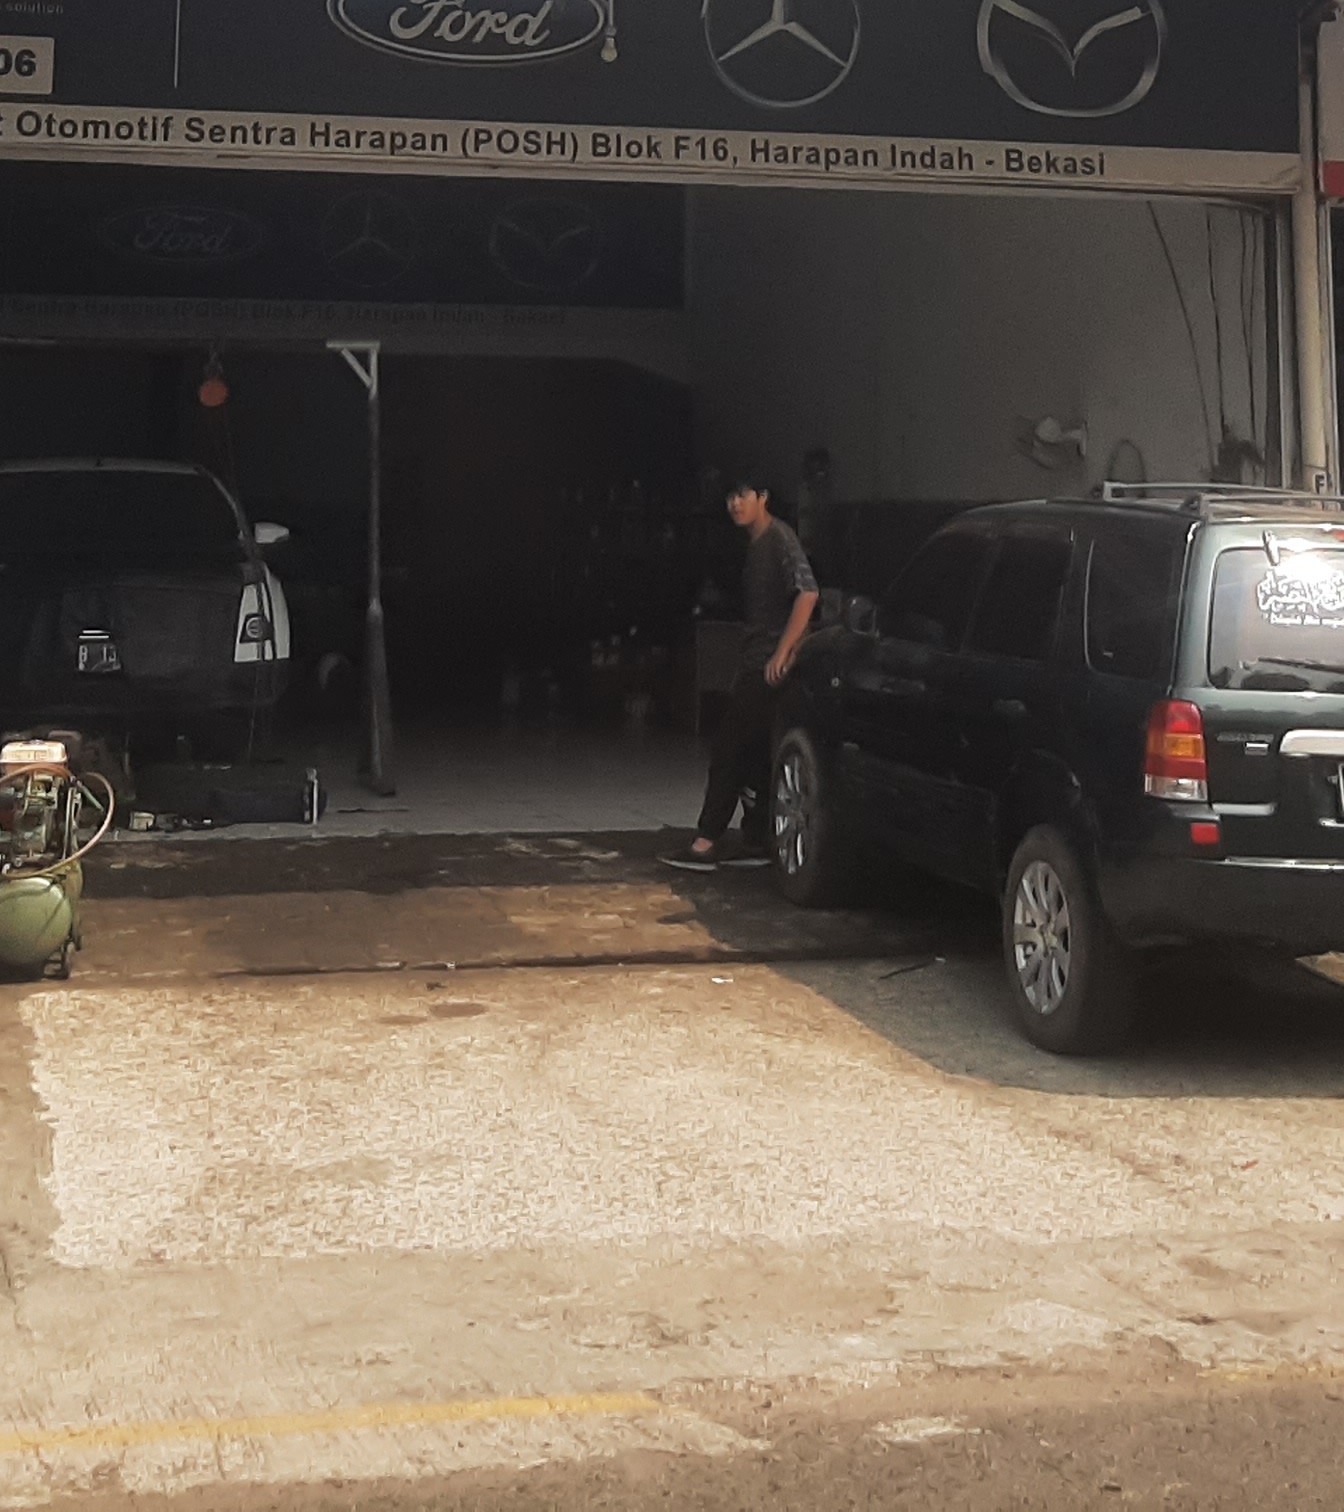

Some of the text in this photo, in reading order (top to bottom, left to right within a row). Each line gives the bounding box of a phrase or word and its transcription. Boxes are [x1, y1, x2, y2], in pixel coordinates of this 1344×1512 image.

[6, 1, 65, 15] solution
[16, 110, 173, 142] Otomotif
[184, 117, 298, 147] Sentra
[309, 122, 449, 156] Harapan
[460, 129, 580, 164] (POSH)
[591, 131, 662, 160] Blok
[673, 135, 739, 167] F16,
[750, 139, 879, 172] Harapan
[889, 142, 974, 172] Indah
[1005, 148, 1106, 176] Bekasi
